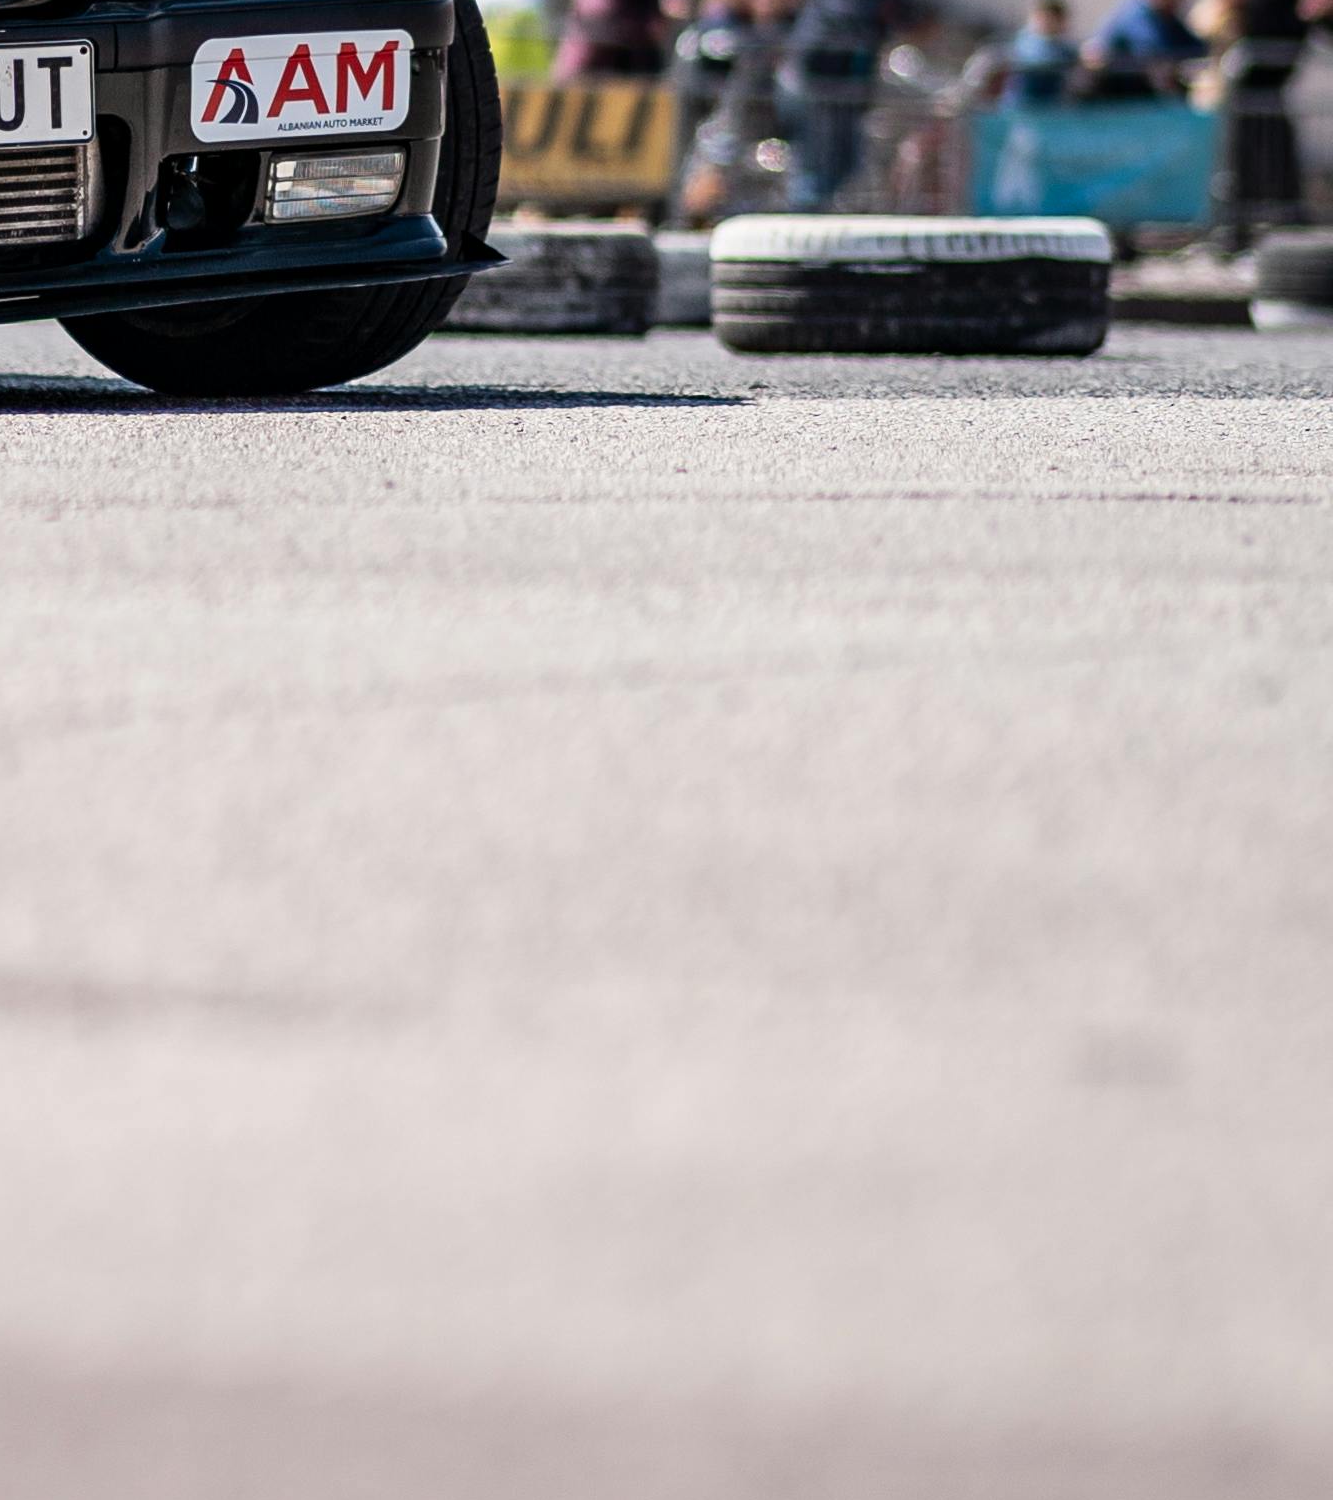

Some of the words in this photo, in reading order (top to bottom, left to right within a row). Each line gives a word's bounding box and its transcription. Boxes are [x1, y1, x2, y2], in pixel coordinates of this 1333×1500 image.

[200, 40, 400, 124] AAM
[277, 121, 322, 131] ALBANIAN
[323, 119, 347, 129] AUTO
[349, 116, 384, 128] MARKET
[504, 86, 657, 158] ULI
